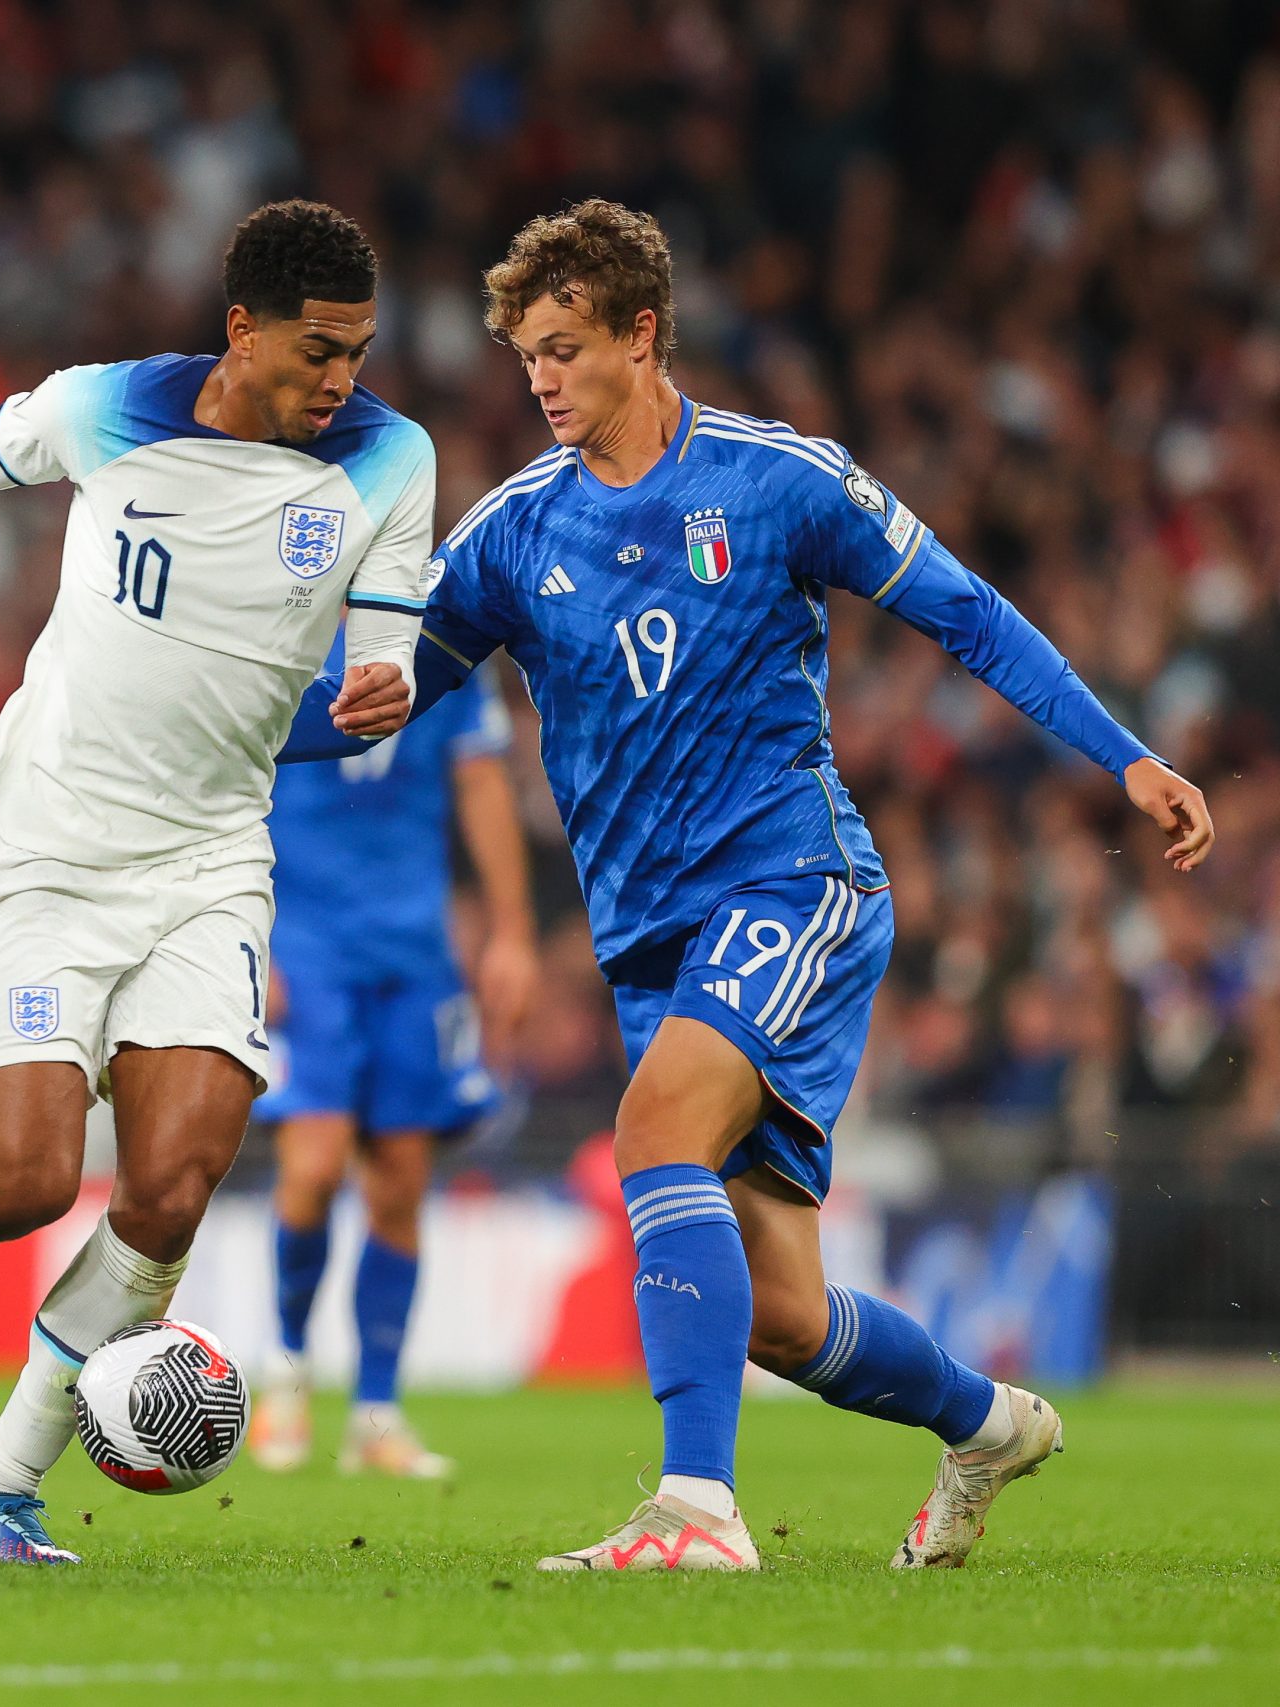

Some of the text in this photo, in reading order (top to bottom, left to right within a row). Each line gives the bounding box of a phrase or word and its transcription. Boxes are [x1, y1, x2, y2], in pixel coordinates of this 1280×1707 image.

[688, 523, 723, 541] ITALIA
[113, 530, 172, 621] 10
[614, 608, 678, 699] 19
[708, 908, 792, 978] 19
